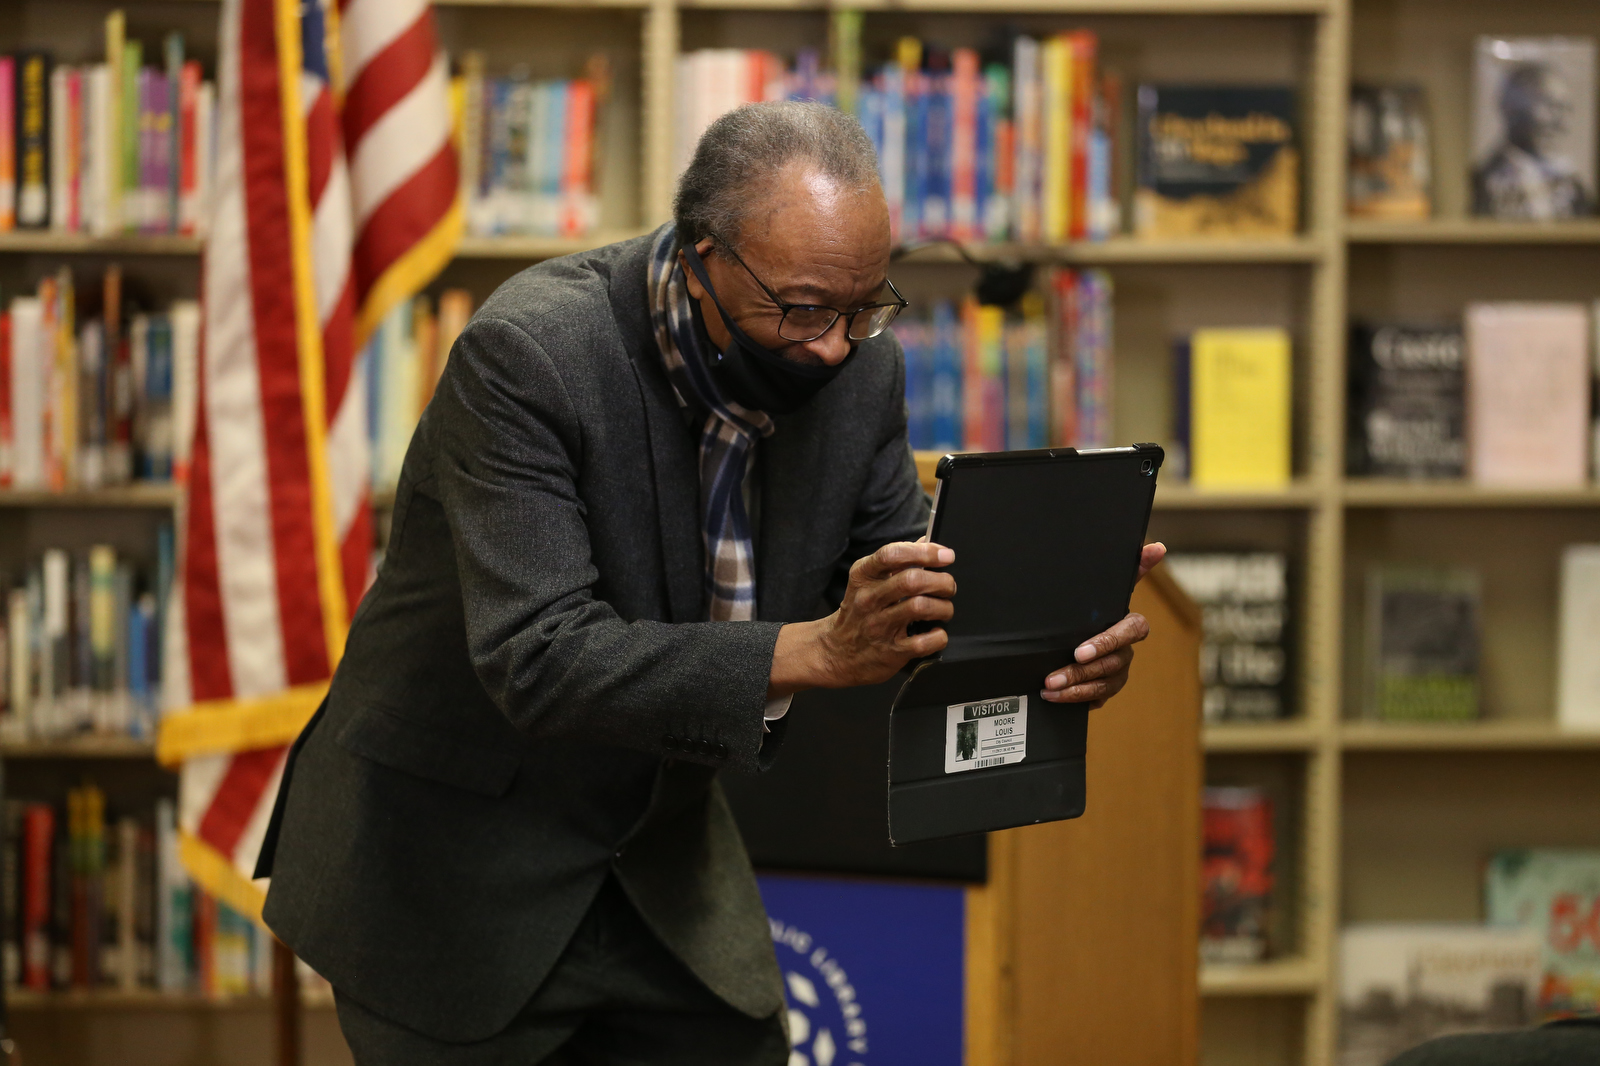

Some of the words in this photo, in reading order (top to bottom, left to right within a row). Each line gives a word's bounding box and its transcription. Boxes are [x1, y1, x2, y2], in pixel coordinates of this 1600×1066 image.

[972, 702, 1010, 716] VISITOR
[994, 717, 1015, 727] MOORE
[995, 727, 1013, 737] LOUIS
[810, 946, 869, 1055] LIBRARY
